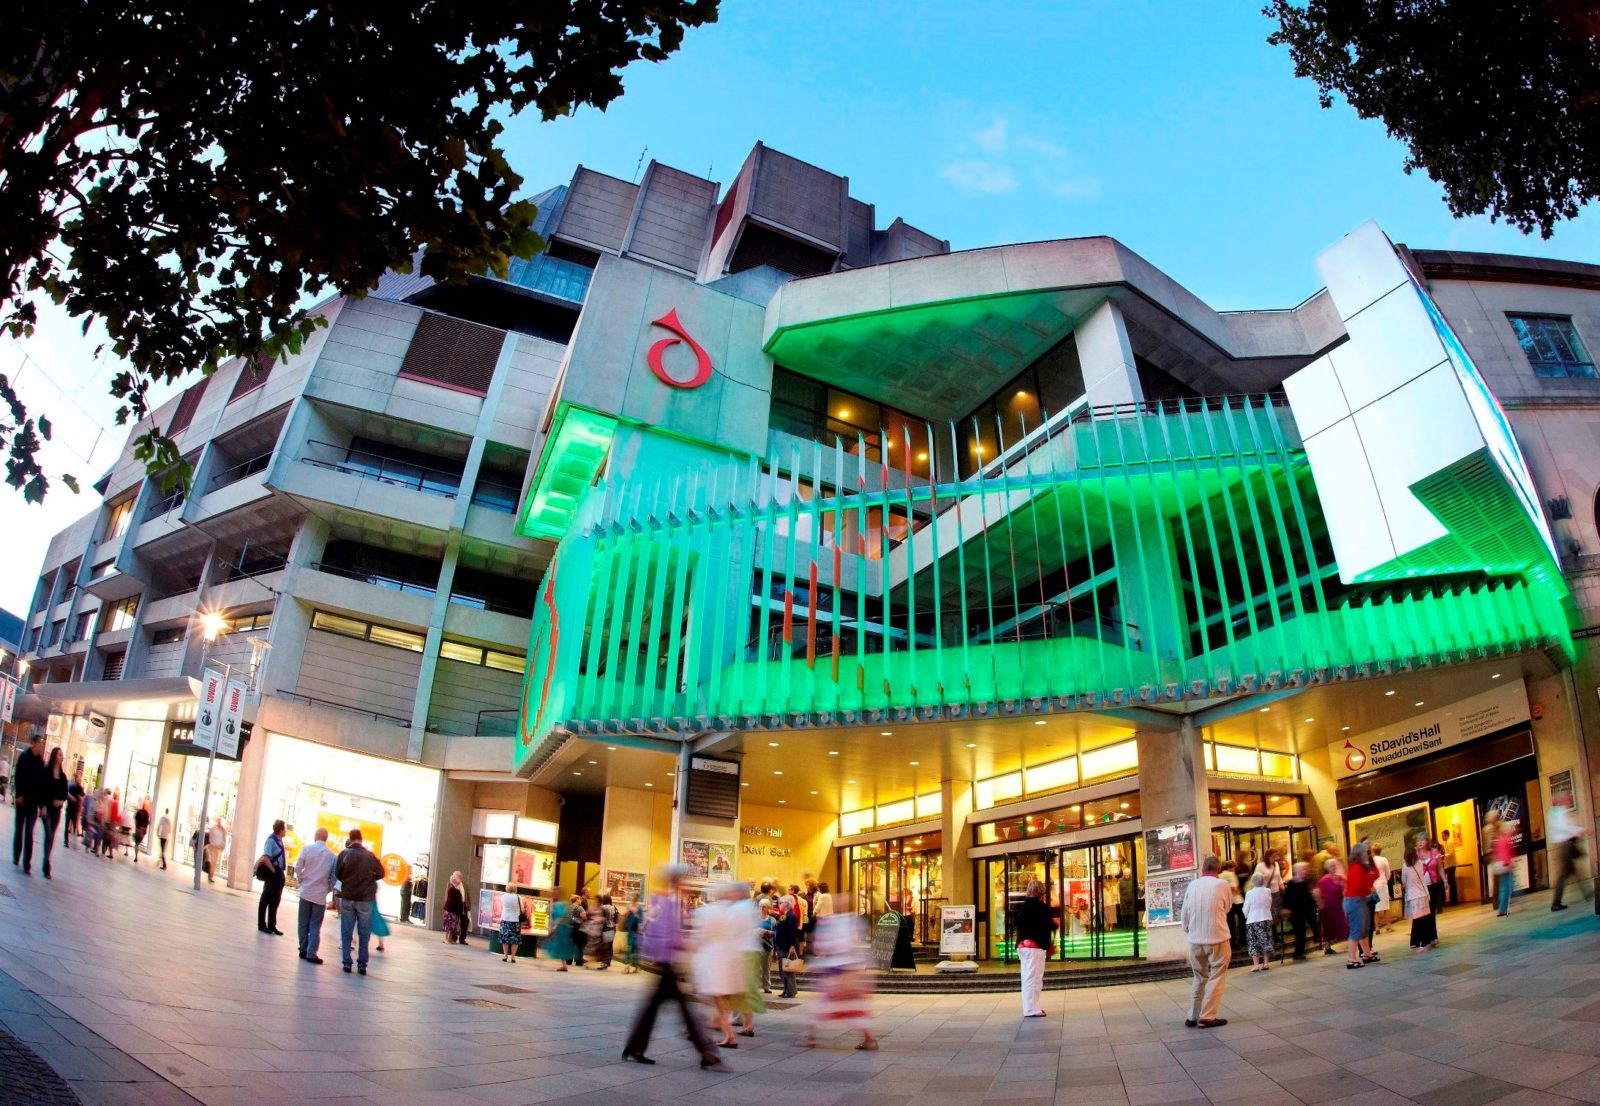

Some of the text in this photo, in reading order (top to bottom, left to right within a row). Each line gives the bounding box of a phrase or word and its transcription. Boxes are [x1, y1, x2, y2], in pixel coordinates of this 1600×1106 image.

[207, 677, 218, 704] PROMS
[230, 687, 241, 713] PROMS
[1369, 723, 1441, 755] St David's Hall
[1371, 737, 1442, 766] Neuadd Dewi Sant
[765, 827, 783, 838] Hall
